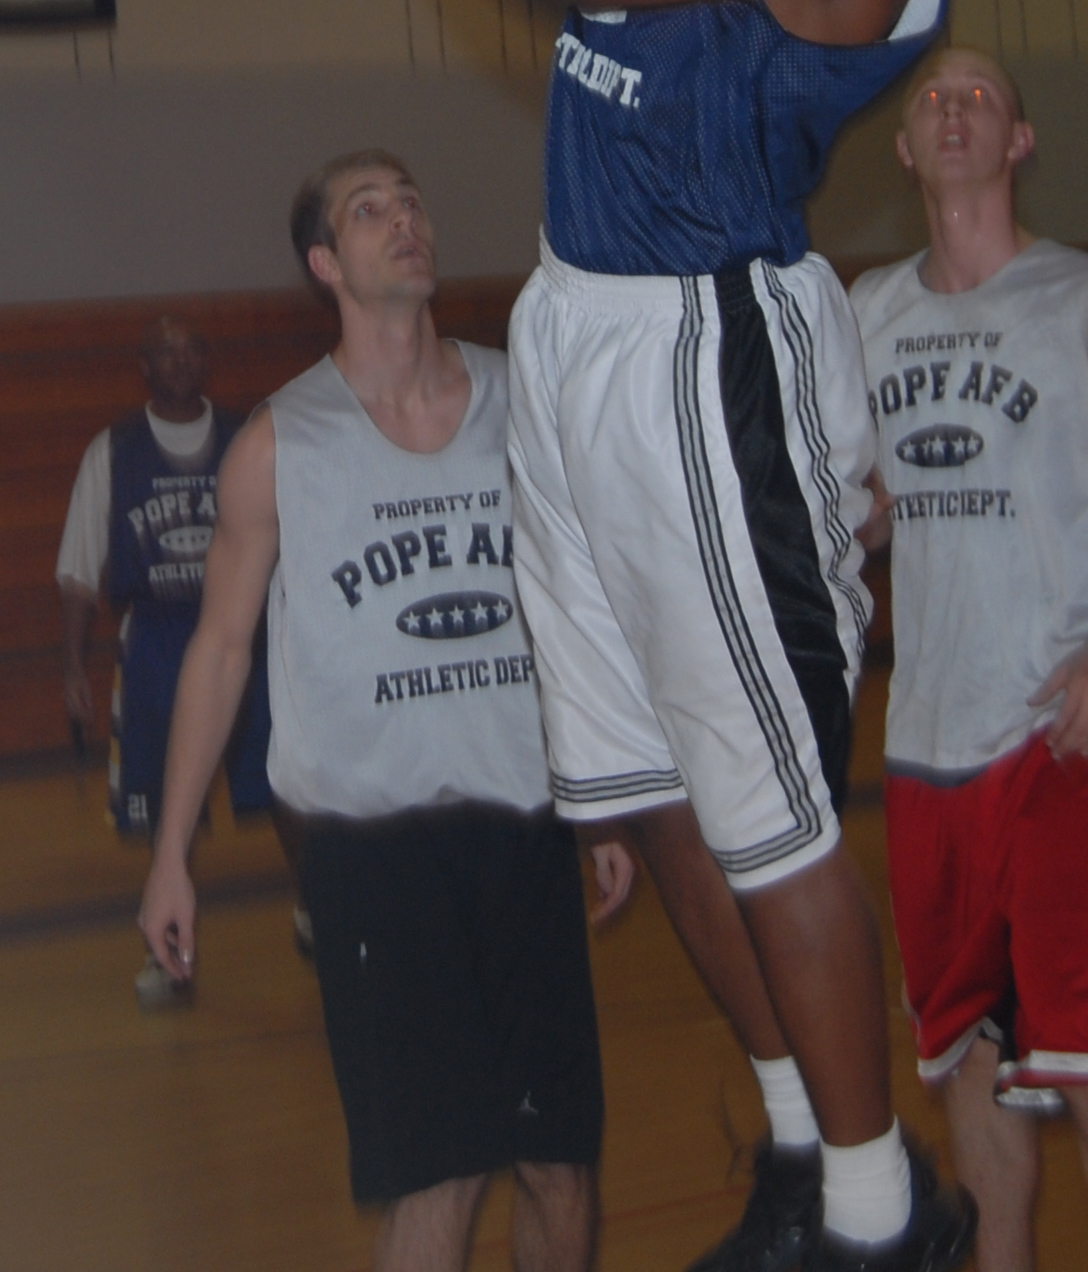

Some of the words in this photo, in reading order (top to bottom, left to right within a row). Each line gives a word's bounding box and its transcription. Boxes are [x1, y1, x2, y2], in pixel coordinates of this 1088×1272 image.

[984, 331, 1004, 348] OF
[958, 360, 1039, 424] AFB
[127, 490, 191, 533] POPE
[372, 492, 474, 520] PROPERTY
[478, 489, 502, 509] OF
[148, 561, 205, 581] ATHLETI
[331, 523, 453, 609] POPE
[374, 658, 491, 704] ATHLETIC
[493, 653, 535, 686] DEP
